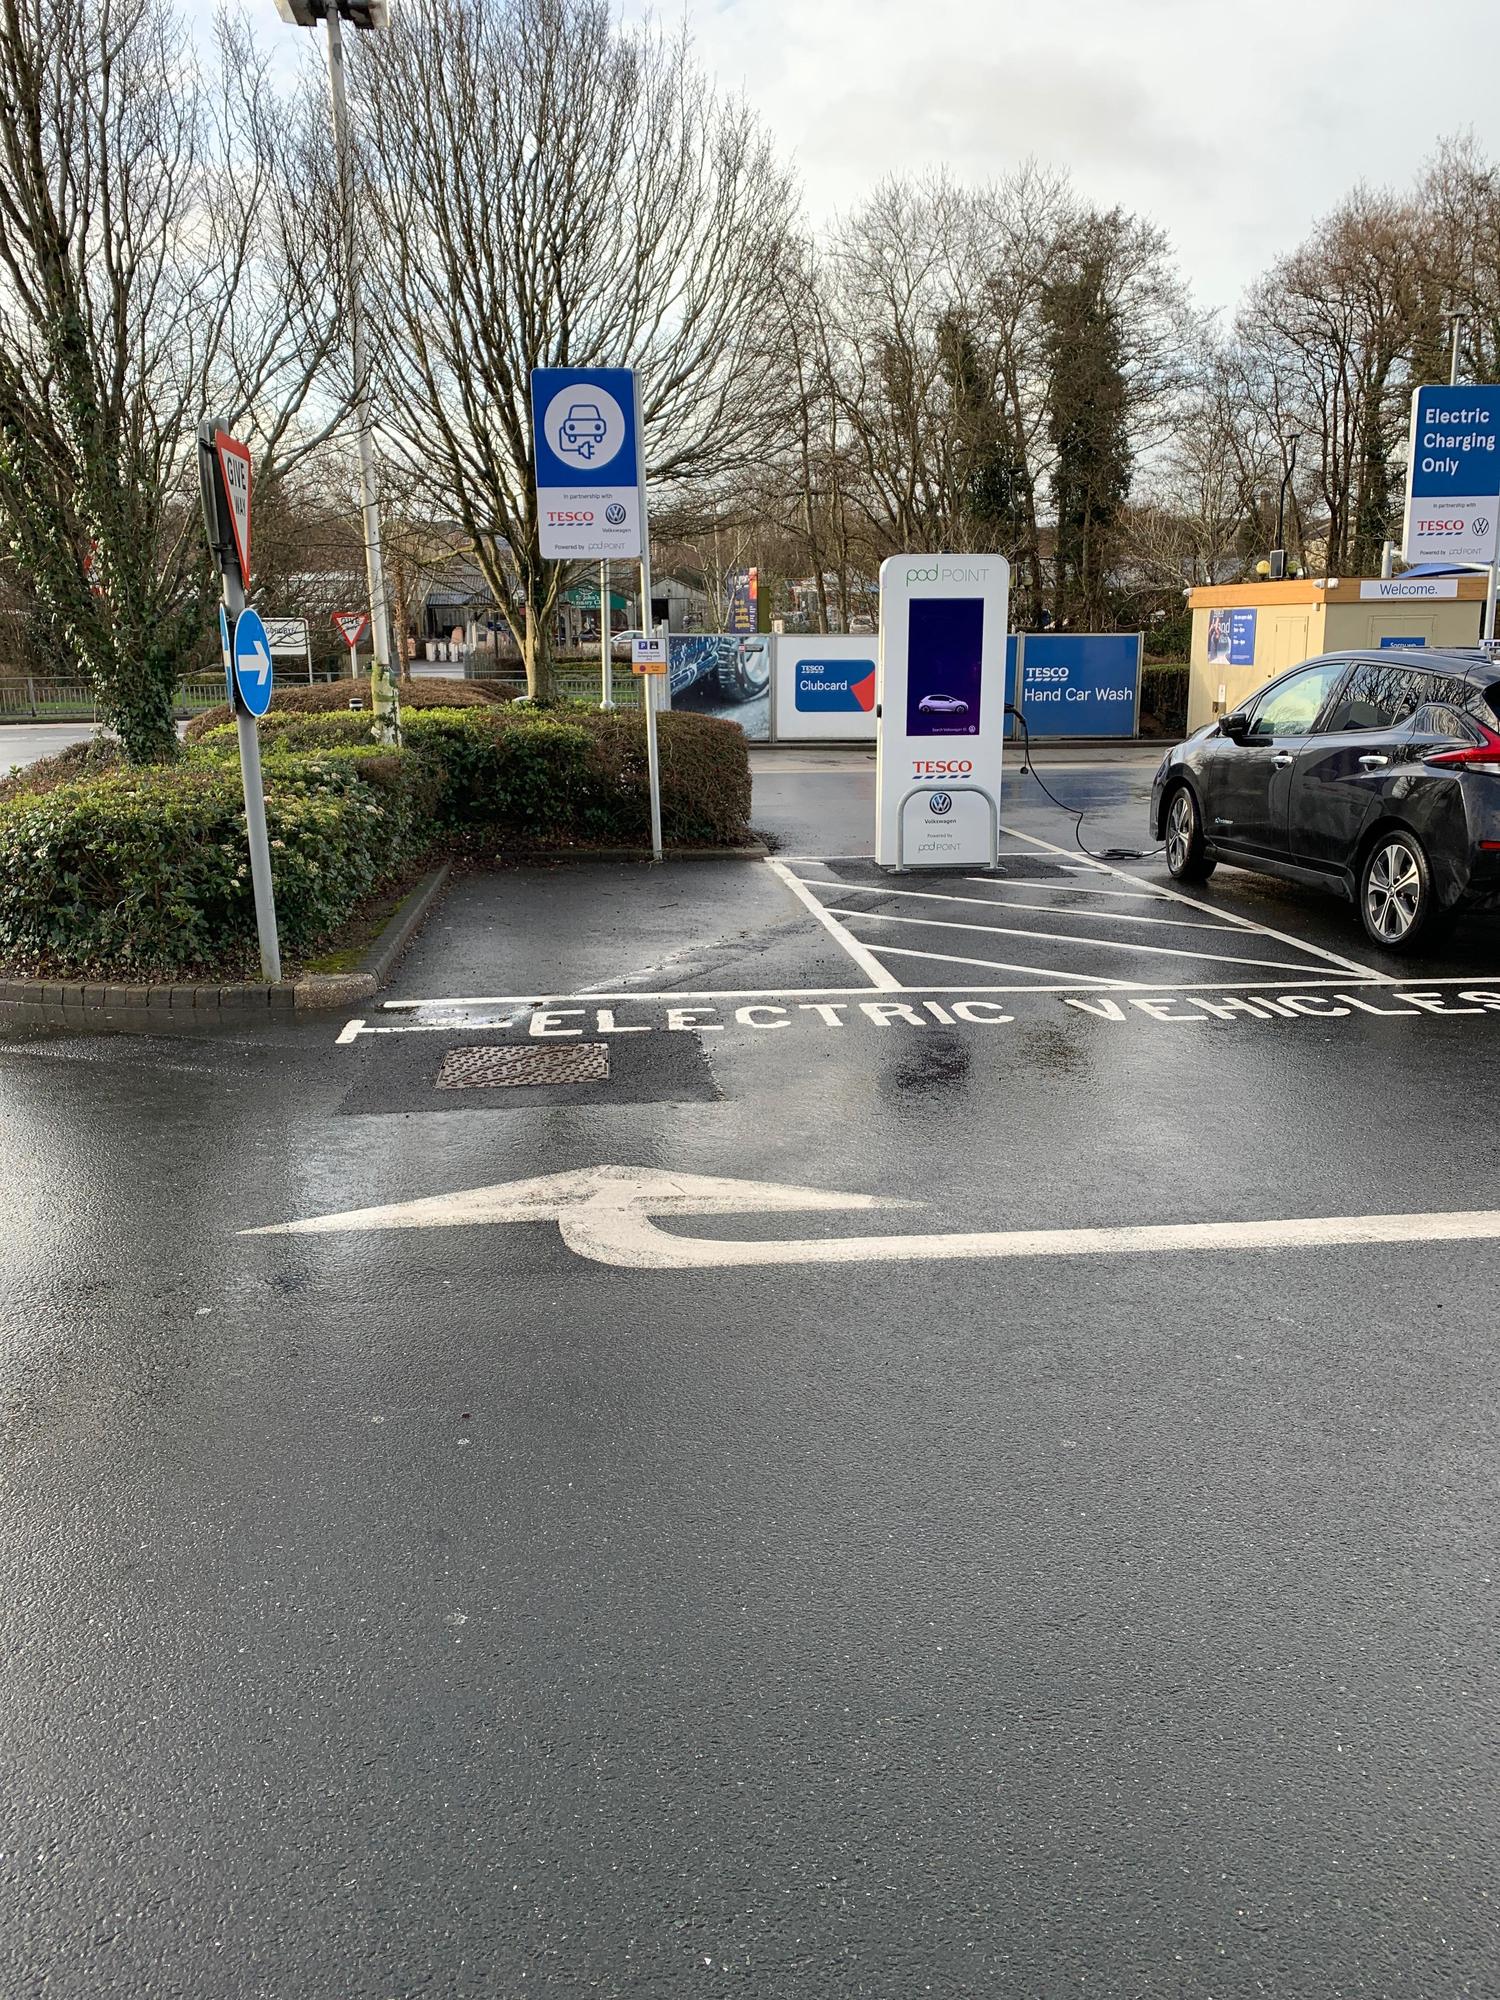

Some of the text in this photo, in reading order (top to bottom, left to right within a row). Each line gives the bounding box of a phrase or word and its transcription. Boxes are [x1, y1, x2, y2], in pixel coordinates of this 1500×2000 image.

[1425, 408, 1490, 424] Electric
[1423, 432, 1496, 452] Charging
[1421, 457, 1459, 476] Only
[227, 457, 247, 491] GIVE
[233, 495, 246, 516] WAY
[547, 511, 594, 522] TESCO
[1417, 519, 1465, 531] TESCO
[906, 563, 990, 588] pod POINT
[1380, 583, 1438, 595] Welcome.
[1026, 667, 1069, 677] TESCO
[800, 680, 848, 691] Clubcard
[1024, 686, 1133, 701] Hand Car Wash
[912, 760, 972, 774] TESCO
[924, 818, 957, 826] Volkswagen
[936, 842, 961, 852] POINT
[529, 1001, 1015, 1036] ELECTRIC
